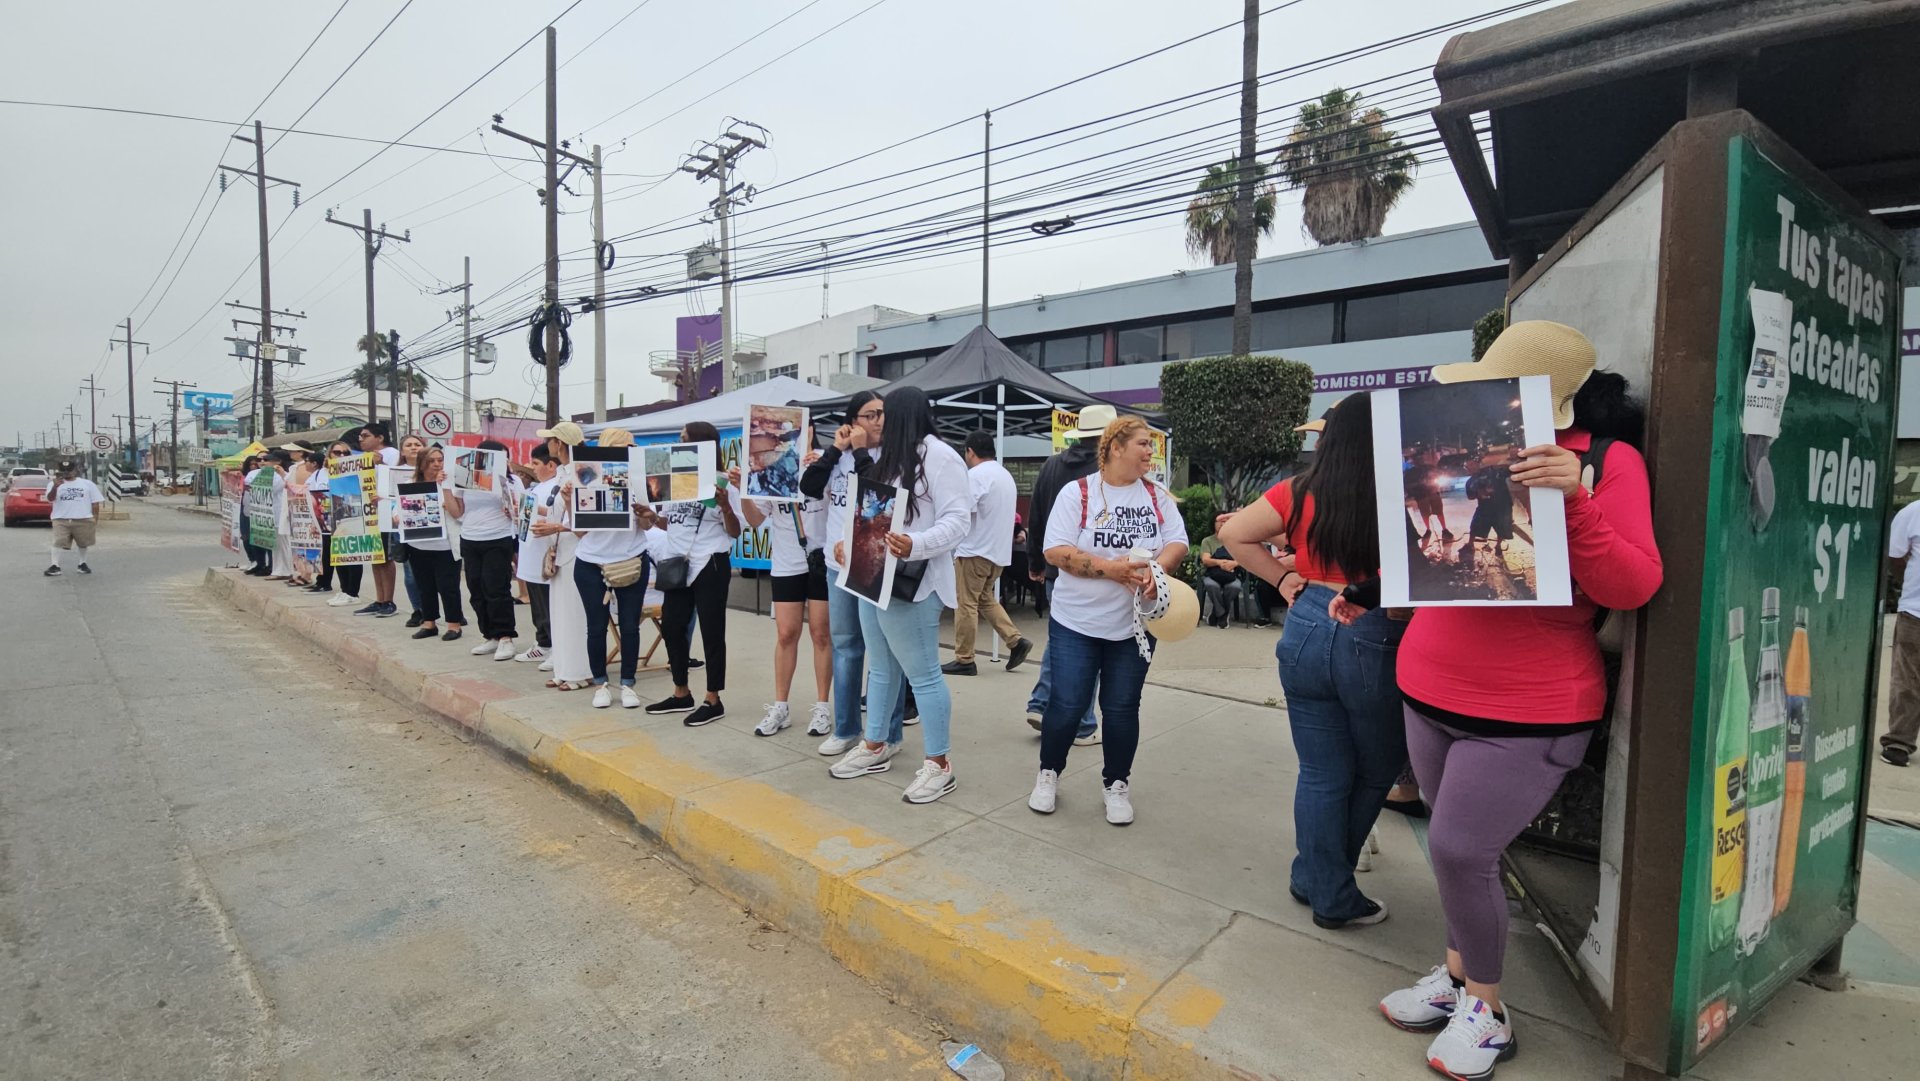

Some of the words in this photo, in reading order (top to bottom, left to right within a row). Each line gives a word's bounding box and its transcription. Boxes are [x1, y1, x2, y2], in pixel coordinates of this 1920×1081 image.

[1777, 194, 1821, 289] Tus
[1827, 236, 1885, 326] tapas
[1790, 316, 1880, 404] ateadas
[1313, 374, 1386, 390] COMISION
[1808, 437, 1876, 509] valen
[778, 502, 807, 514] FUAS
[1115, 506, 1155, 519] CHINGA
[1127, 517, 1151, 526] FALLA
[1094, 532, 1133, 549] FUGAS
